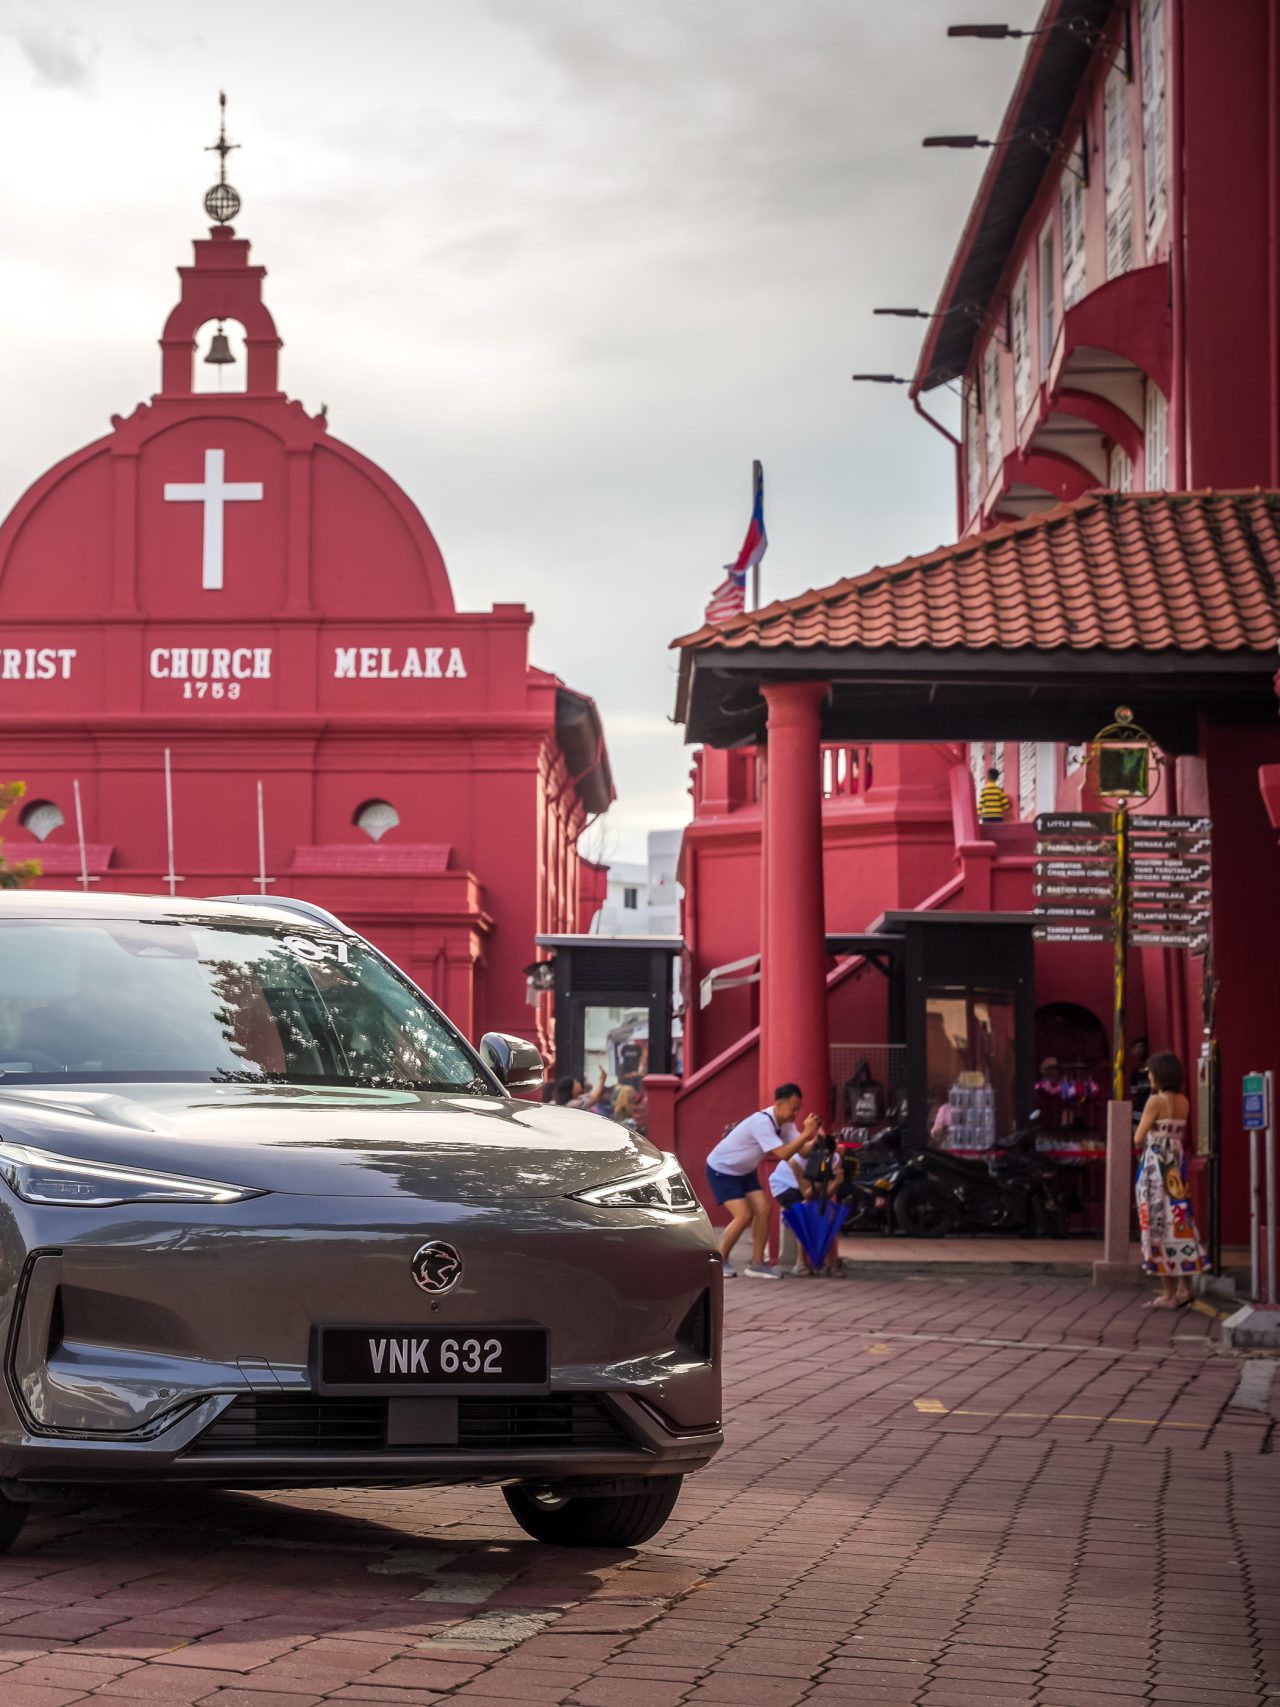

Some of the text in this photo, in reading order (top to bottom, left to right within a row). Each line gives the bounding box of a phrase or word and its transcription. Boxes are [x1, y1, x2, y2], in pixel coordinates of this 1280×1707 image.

[150, 647, 272, 680] CHURCH
[334, 647, 467, 679] MELAKA
[183, 681, 241, 700] 1753
[369, 1339, 503, 1373] VNK 632
